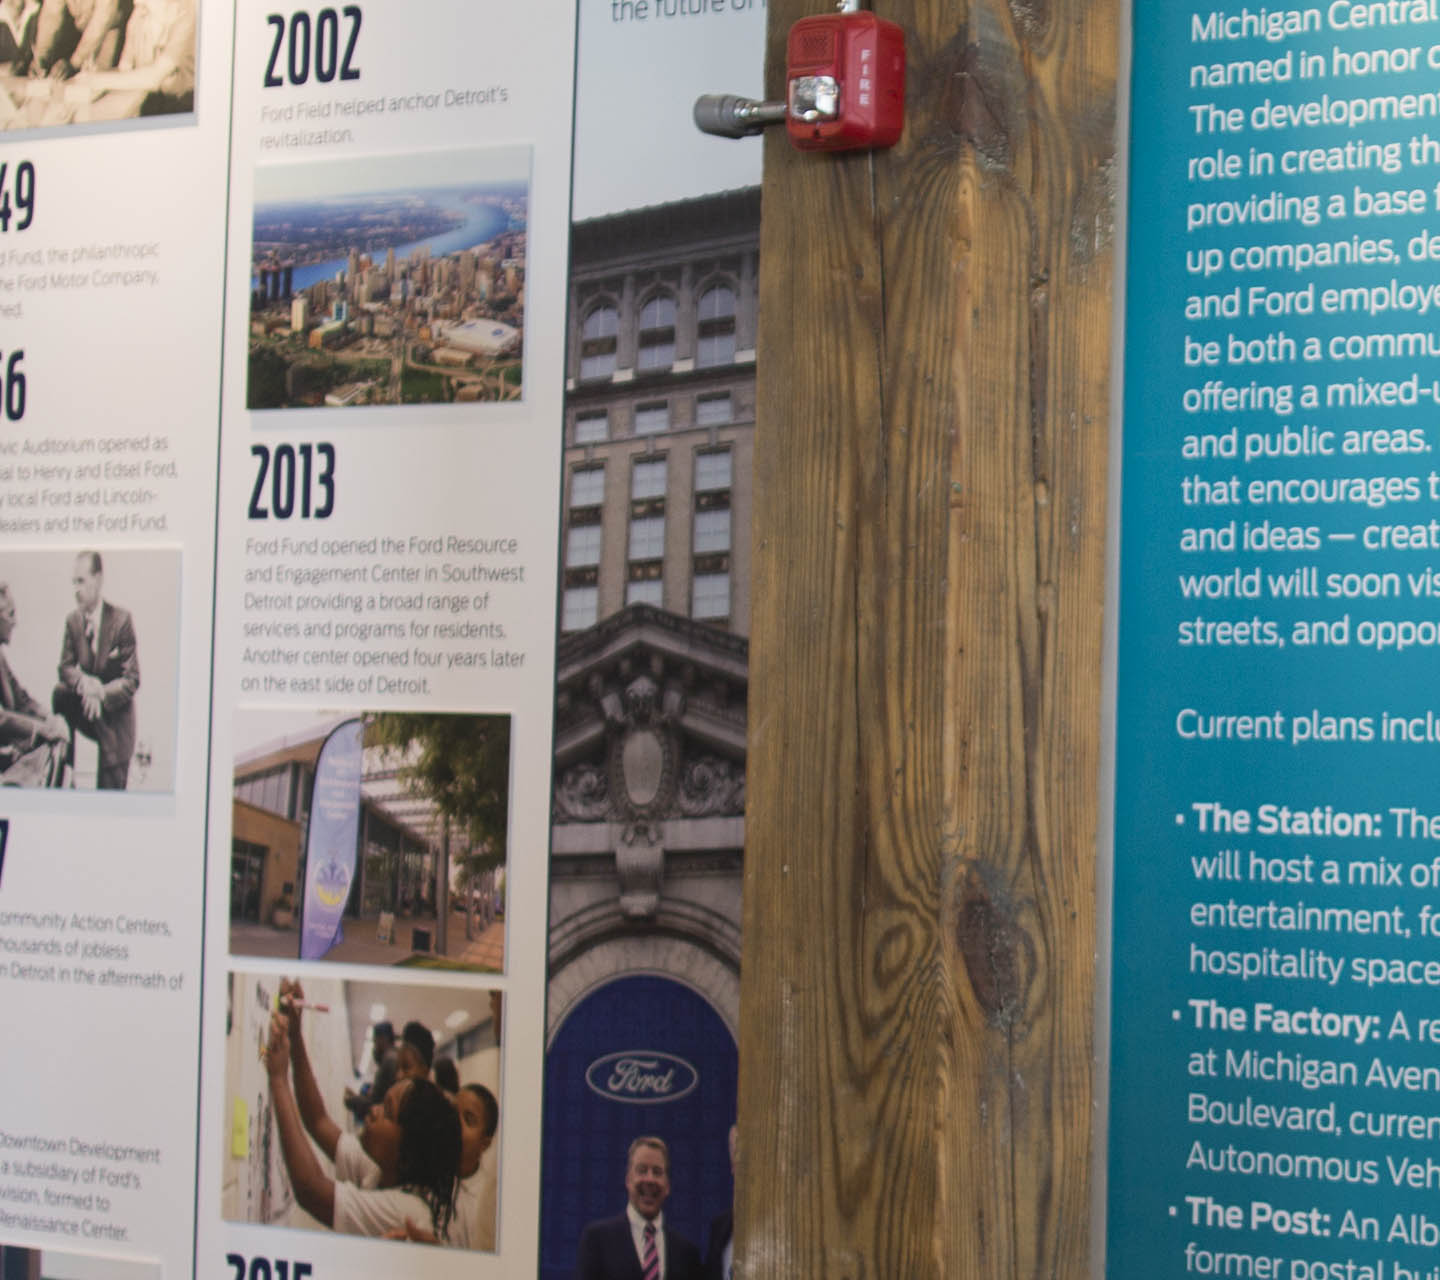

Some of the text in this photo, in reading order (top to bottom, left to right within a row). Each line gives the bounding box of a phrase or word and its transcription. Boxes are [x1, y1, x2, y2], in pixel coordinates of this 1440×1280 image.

[1191, 7, 1322, 42] Michigan
[264, 5, 362, 88] 2002
[860, 49, 872, 106] FIRE
[248, 442, 336, 520] 2013
[1176, 708, 1285, 739] Current
[1292, 709, 1375, 745] plans
[1192, 802, 1251, 834] The
[1257, 804, 1382, 837] Station:
[607, 1058, 676, 1093] Ford
